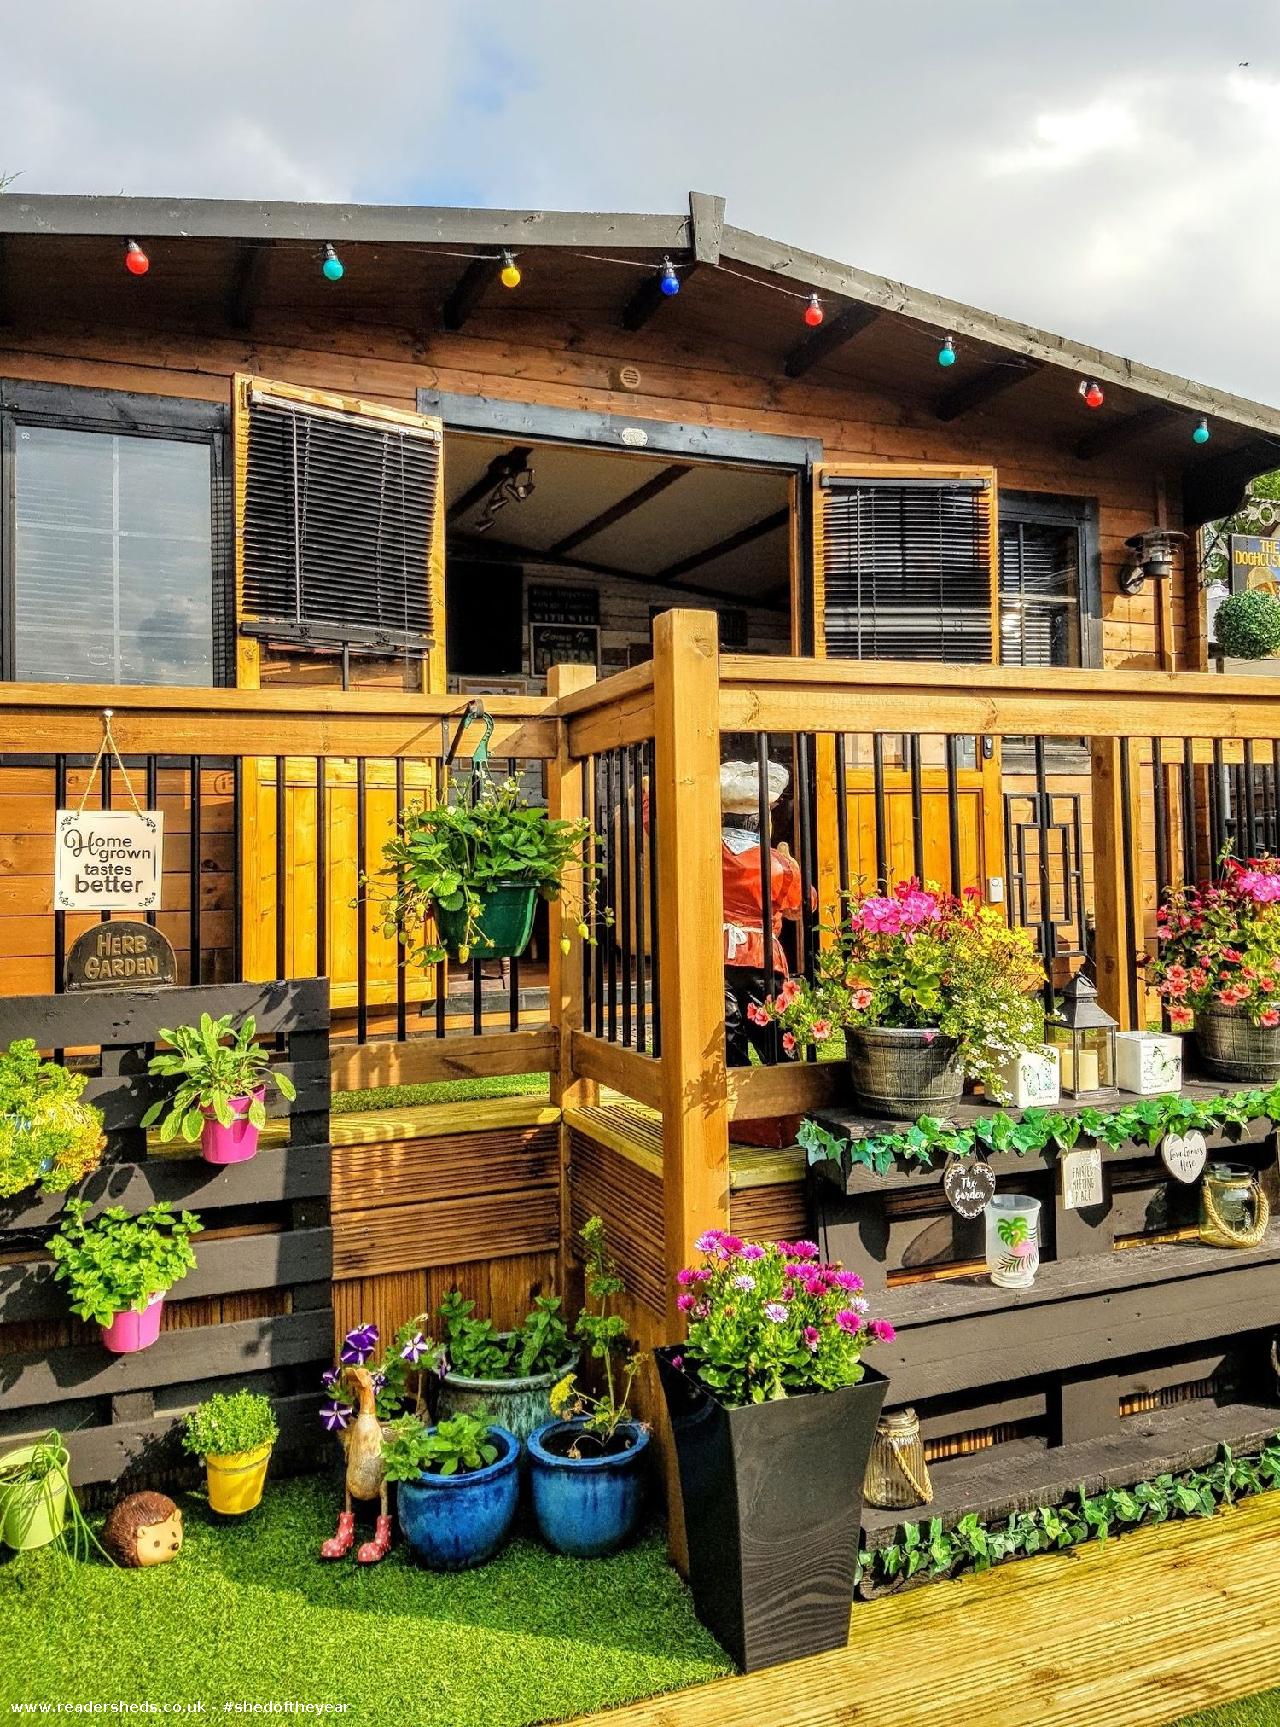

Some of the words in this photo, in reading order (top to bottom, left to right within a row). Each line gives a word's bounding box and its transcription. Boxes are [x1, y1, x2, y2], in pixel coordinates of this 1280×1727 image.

[1261, 540, 1280, 554] THE
[64, 829, 132, 858] Home
[98, 849, 151, 863] grown
[84, 863, 132, 876] tastes
[75, 874, 144, 893] better
[96, 932, 147, 957] HERB
[84, 956, 159, 980] GARDEN
[961, 1176, 977, 1190] The
[954, 1188, 986, 1204] Garden
